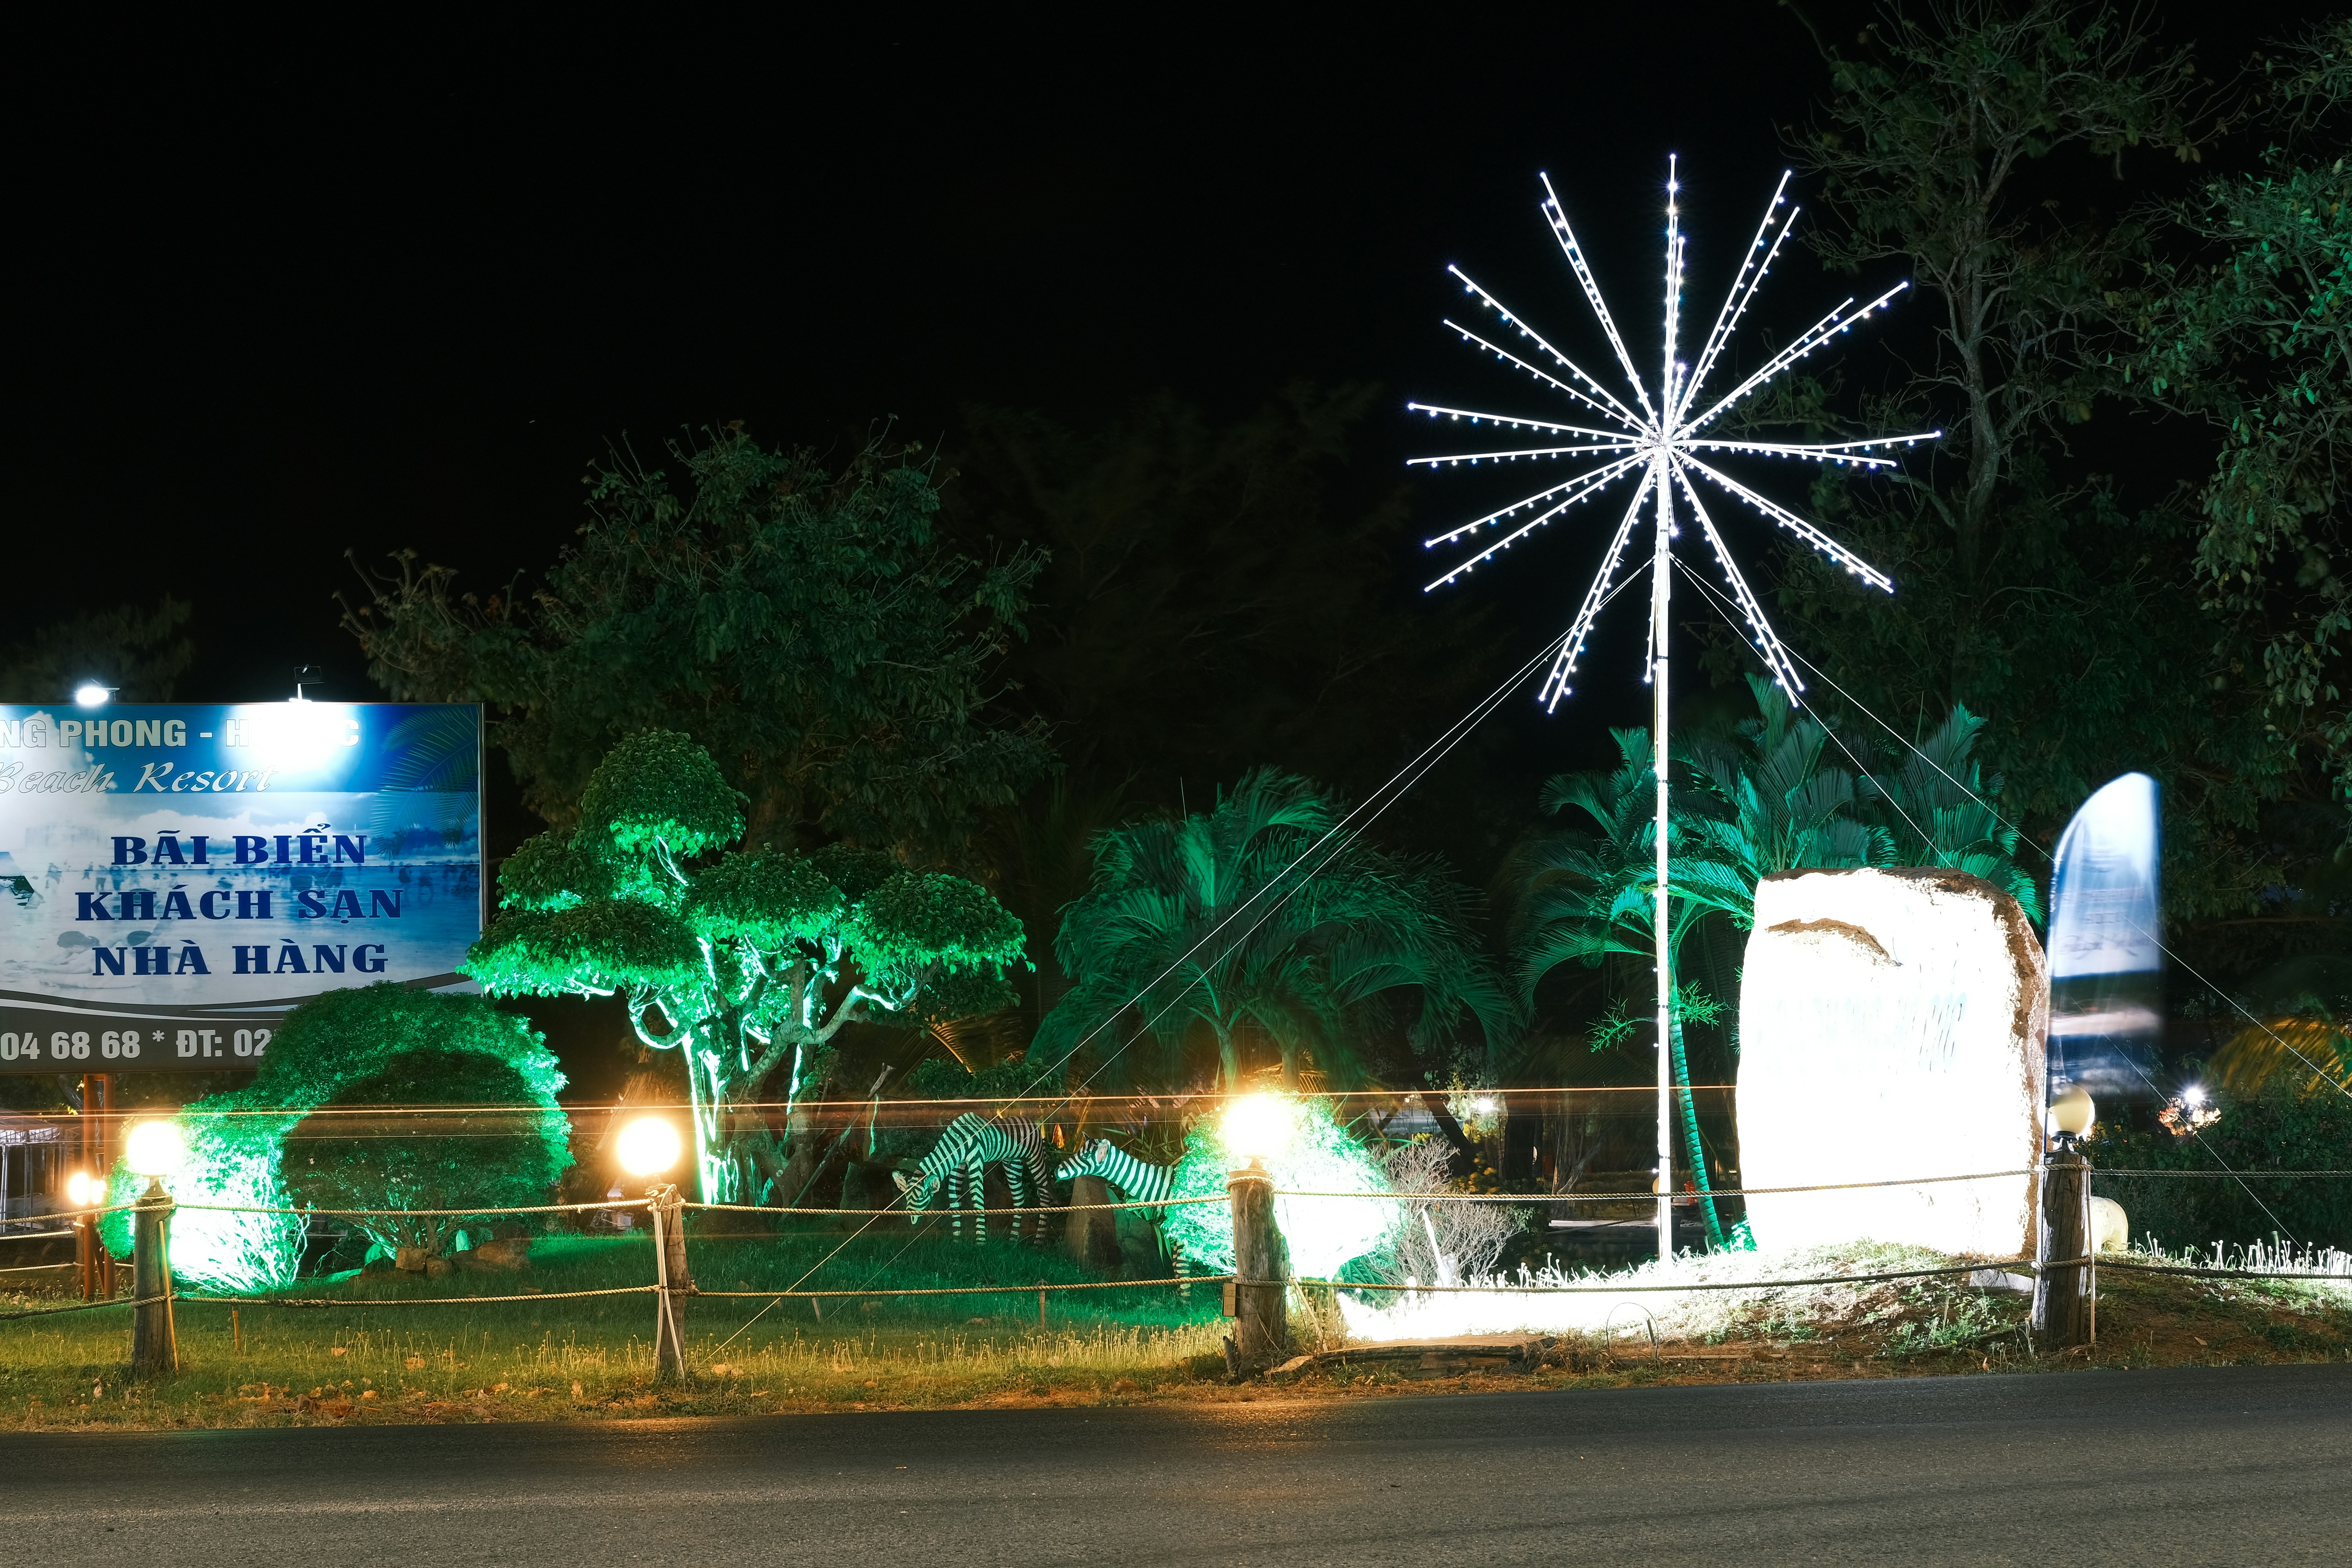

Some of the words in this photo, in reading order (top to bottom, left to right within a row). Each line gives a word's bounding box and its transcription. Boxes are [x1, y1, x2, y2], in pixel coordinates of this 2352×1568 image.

[60, 719, 186, 747] PHONG
[0, 761, 115, 793] Beach
[132, 762, 279, 793] Resort
[111, 830, 210, 865] BÃI
[232, 823, 367, 865] BIỂN
[75, 884, 274, 921] KHÁCH
[297, 889, 404, 924] SẠN
[92, 939, 211, 976] NHÀ
[232, 938, 389, 974] HÀNG
[0, 1032, 40, 1060] 04
[51, 1031, 90, 1060] 68
[101, 1031, 141, 1059] 68
[176, 1029, 223, 1057] ĐT:
